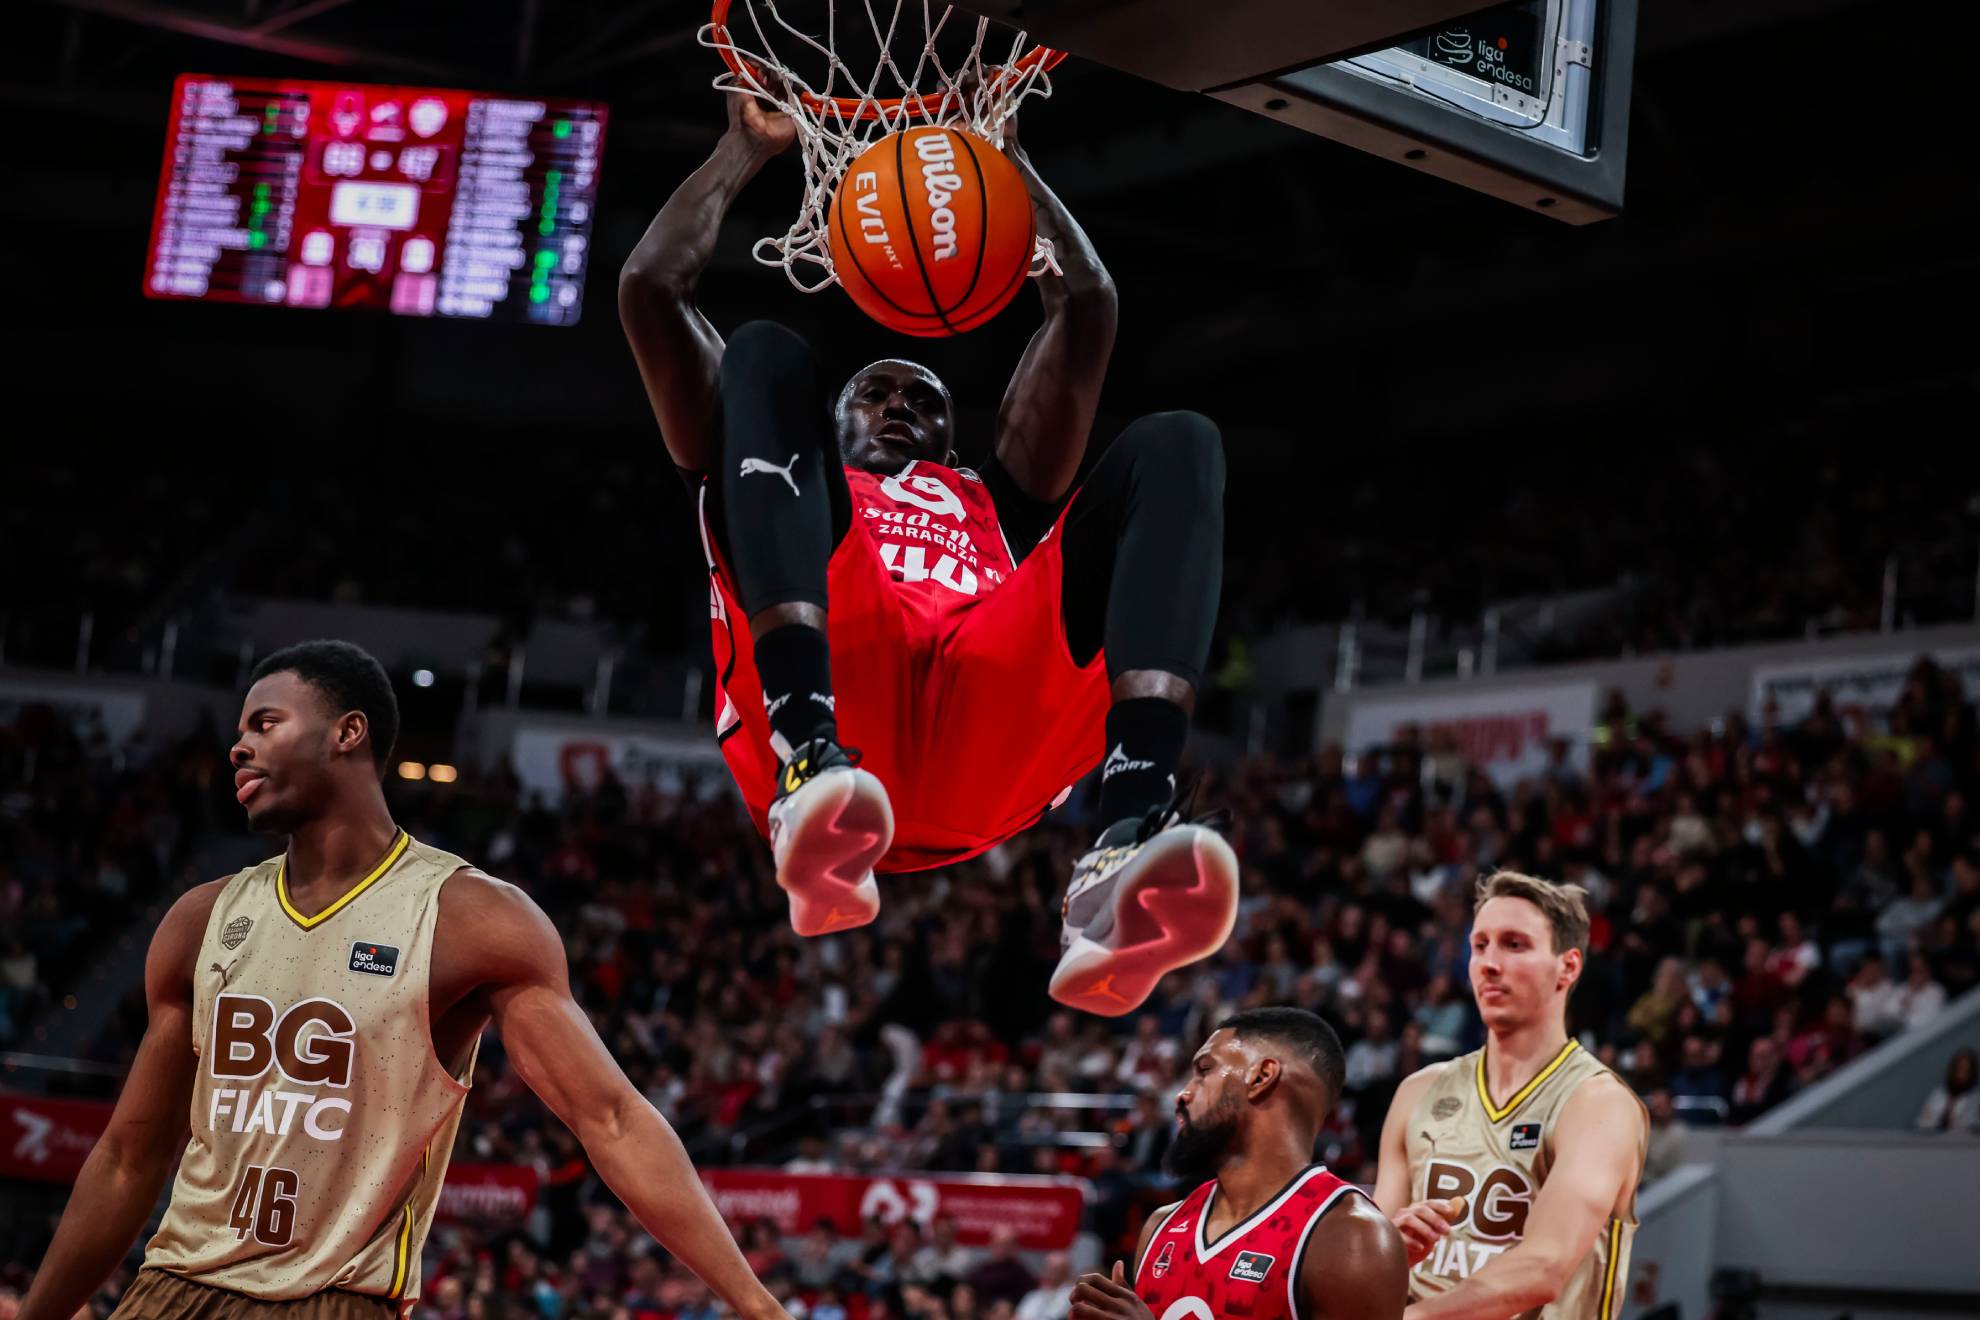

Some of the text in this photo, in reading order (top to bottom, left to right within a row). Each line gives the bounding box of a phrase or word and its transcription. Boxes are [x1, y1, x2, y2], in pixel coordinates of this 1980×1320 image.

[1477, 60, 1532, 90] endesa
[1478, 40, 1504, 62] liga
[856, 171, 903, 270] EVO NXT
[914, 133, 962, 262] Wilson
[879, 524, 977, 568] ZARAGOZA
[353, 960, 393, 973] endesa
[354, 950, 374, 961] liga
[211, 993, 356, 1089] BG
[209, 1088, 353, 1141] FIATC
[229, 1165, 300, 1247] 46
[1424, 1158, 1533, 1242] BG
[1415, 1236, 1505, 1279] IAT
